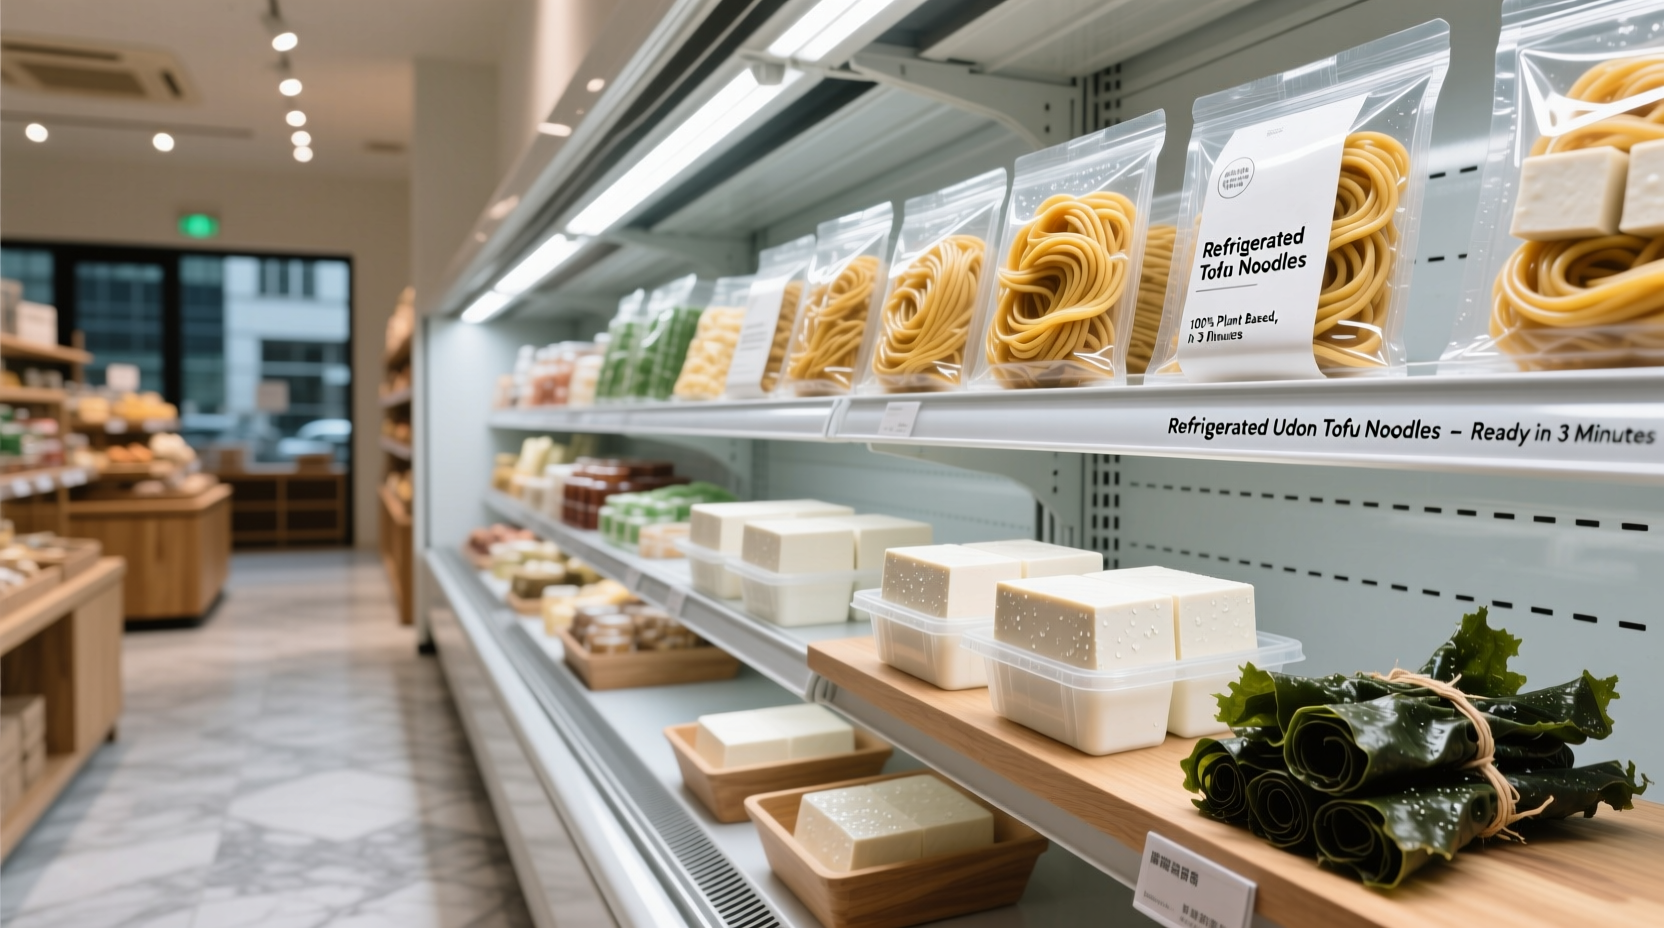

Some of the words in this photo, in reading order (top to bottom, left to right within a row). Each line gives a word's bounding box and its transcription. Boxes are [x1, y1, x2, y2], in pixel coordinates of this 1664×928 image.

[1203, 226, 1305, 258] Refrigerated
[1200, 261, 1233, 280] Tofu
[1239, 252, 1307, 276] Noodles
[1216, 314, 1242, 327] Plant
[1168, 416, 1269, 440] Refrigerated
[1273, 418, 1317, 437] Udon
[1324, 418, 1361, 437] Tofu
[1365, 419, 1441, 438] Noodles
[1471, 421, 1530, 447] Ready
[1534, 423, 1551, 442] in
[1557, 424, 1570, 443] 3
[1574, 424, 1656, 445] Minutes
